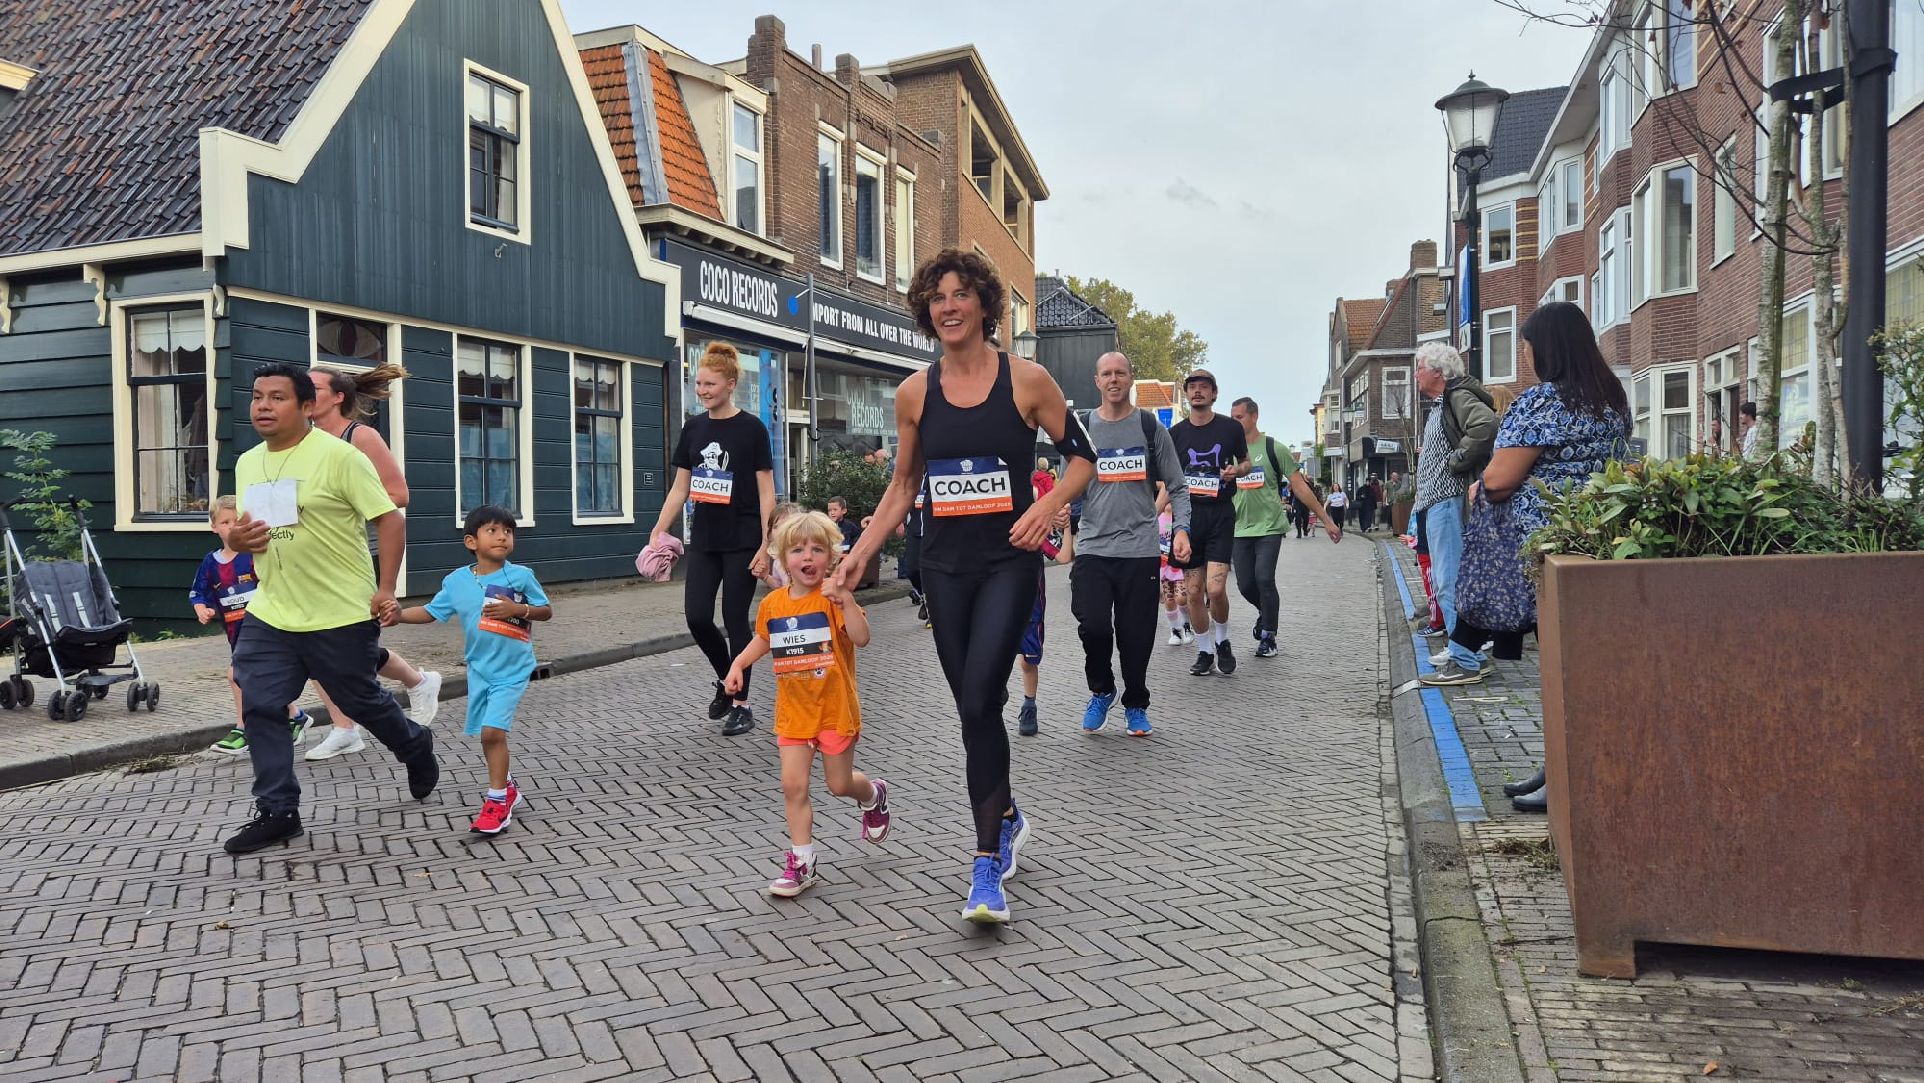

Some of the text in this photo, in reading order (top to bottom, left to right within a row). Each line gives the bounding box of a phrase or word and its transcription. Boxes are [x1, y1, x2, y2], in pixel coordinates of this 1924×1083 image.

[700, 260, 778, 318] COCO RECORDS
[812, 302, 839, 328] MPORT
[865, 318, 879, 338] ALL
[880, 322, 898, 343] OVER
[898, 327, 912, 347] THE
[851, 404, 884, 429] RECORDS
[1099, 459, 1143, 471] COACH
[692, 479, 729, 493] COACH
[934, 476, 1006, 496] COACH
[1185, 477, 1217, 488] COACH
[783, 634, 806, 644] WIES
